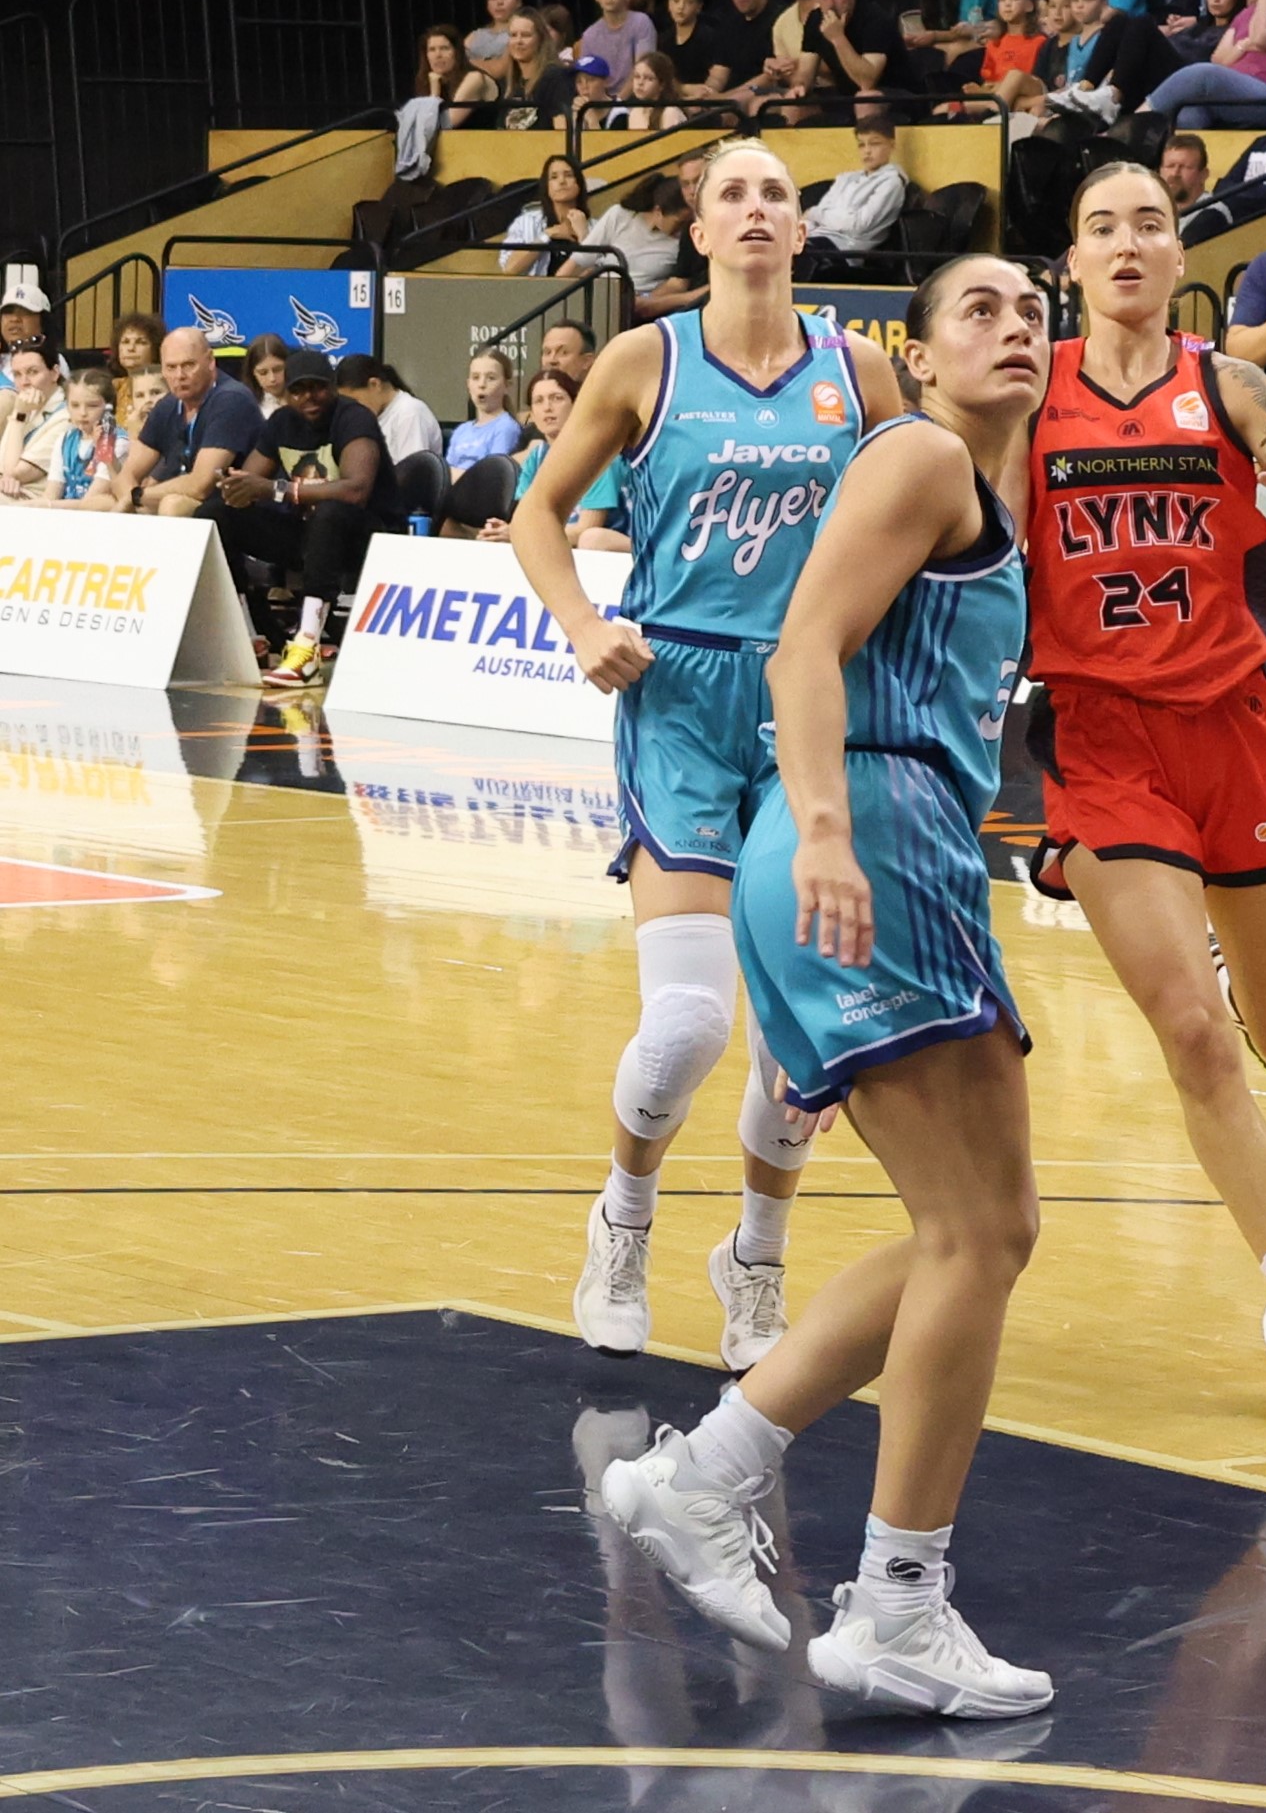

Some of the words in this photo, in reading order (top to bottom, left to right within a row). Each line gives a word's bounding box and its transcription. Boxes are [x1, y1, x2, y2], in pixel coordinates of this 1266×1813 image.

[353, 284, 366, 302] 15
[387, 289, 402, 308] 16
[707, 439, 831, 469] Jayco
[1077, 456, 1173, 474] NORTHERN
[681, 470, 827, 576] Flyer
[1055, 491, 1219, 560] LYNX
[1093, 567, 1192, 631] 24
[37, 608, 51, 625] &
[59, 611, 144, 635] DESIGN
[378, 585, 621, 655] METAL
[472, 655, 576, 684] AUSTRALIA
[835, 982, 880, 1009] label
